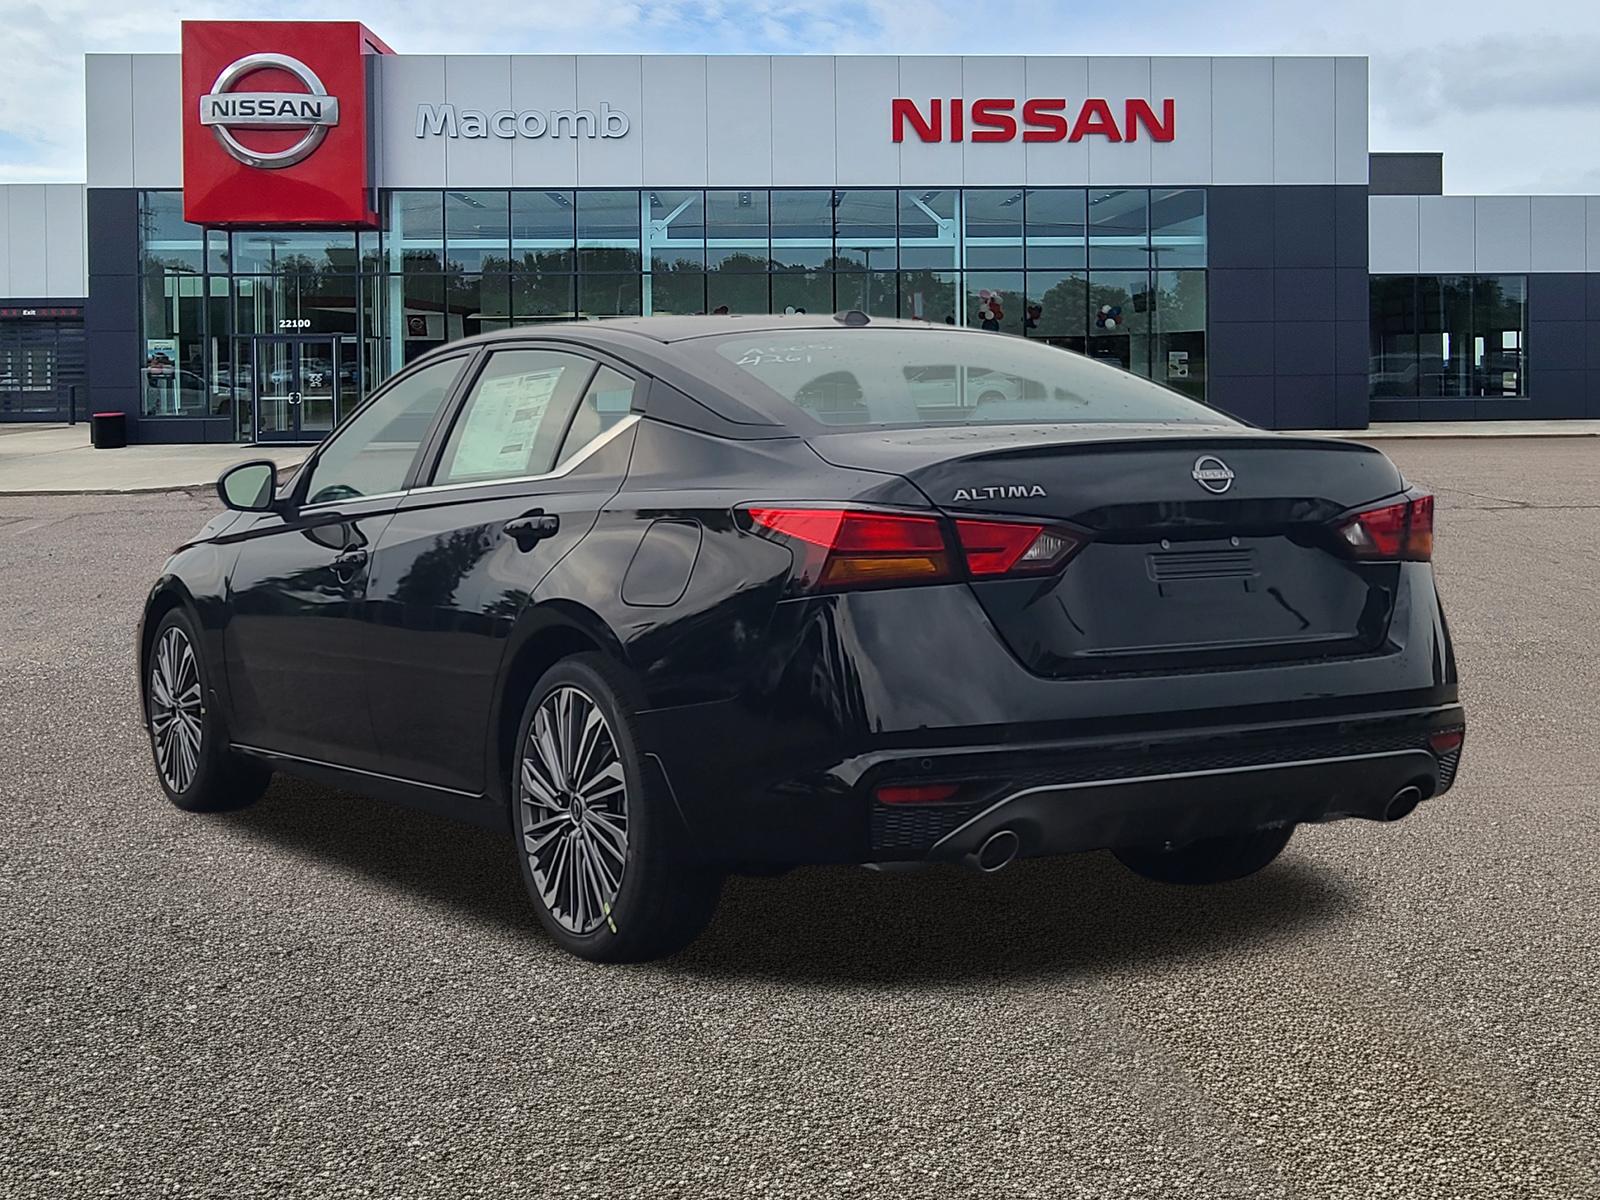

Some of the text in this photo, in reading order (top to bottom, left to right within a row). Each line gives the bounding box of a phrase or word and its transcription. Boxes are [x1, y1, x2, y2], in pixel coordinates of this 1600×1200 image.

[212, 100, 321, 117] NISSAN
[415, 102, 630, 138] Macomb
[892, 98, 1175, 142] NISSAN
[279, 319, 311, 328] 22100
[953, 485, 1047, 501] ALTIMA
